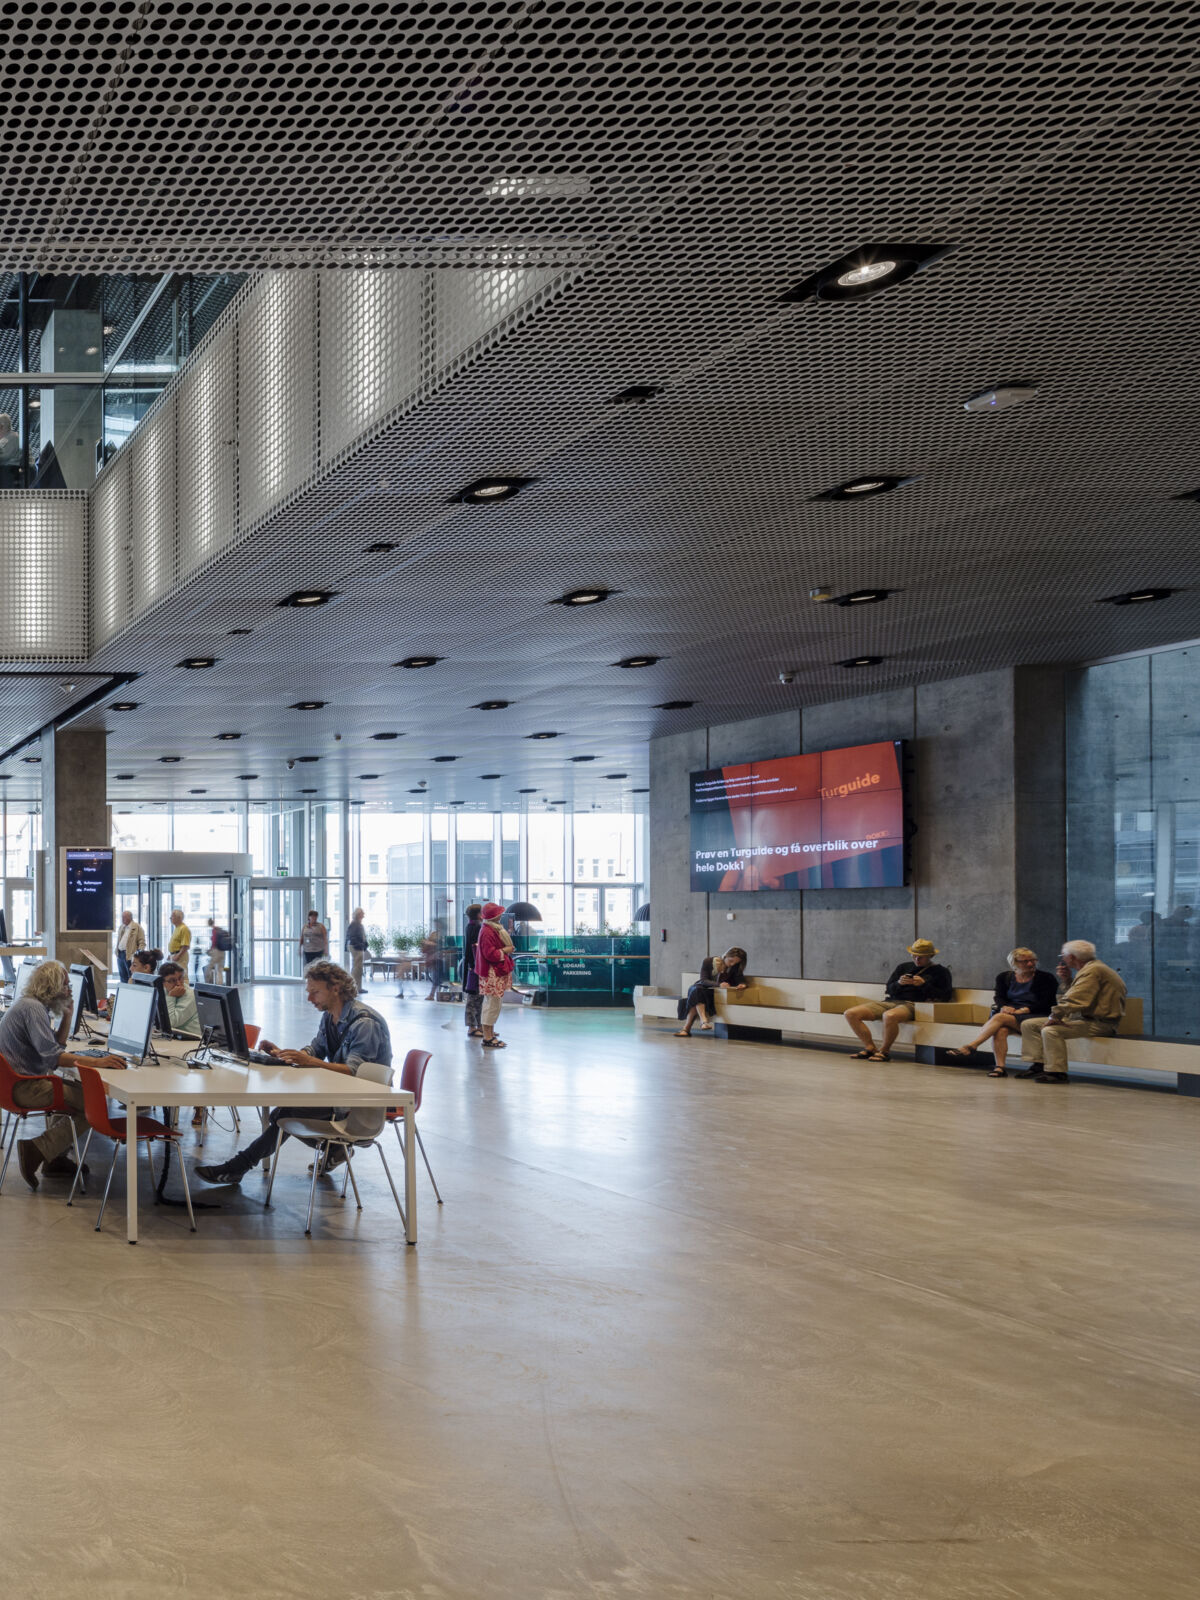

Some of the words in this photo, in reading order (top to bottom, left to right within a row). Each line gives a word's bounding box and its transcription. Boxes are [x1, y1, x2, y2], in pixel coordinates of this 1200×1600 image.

[817, 772, 881, 800] Turguide
[695, 850, 716, 859] Prøv
[717, 849, 729, 858] en
[730, 845, 773, 858] Turguide
[775, 846, 788, 856] og
[790, 843, 801, 854] få
[802, 840, 849, 853] overblik
[851, 839, 879, 849] over
[695, 863, 715, 872] hele
[716, 861, 744, 871] Dokk1
